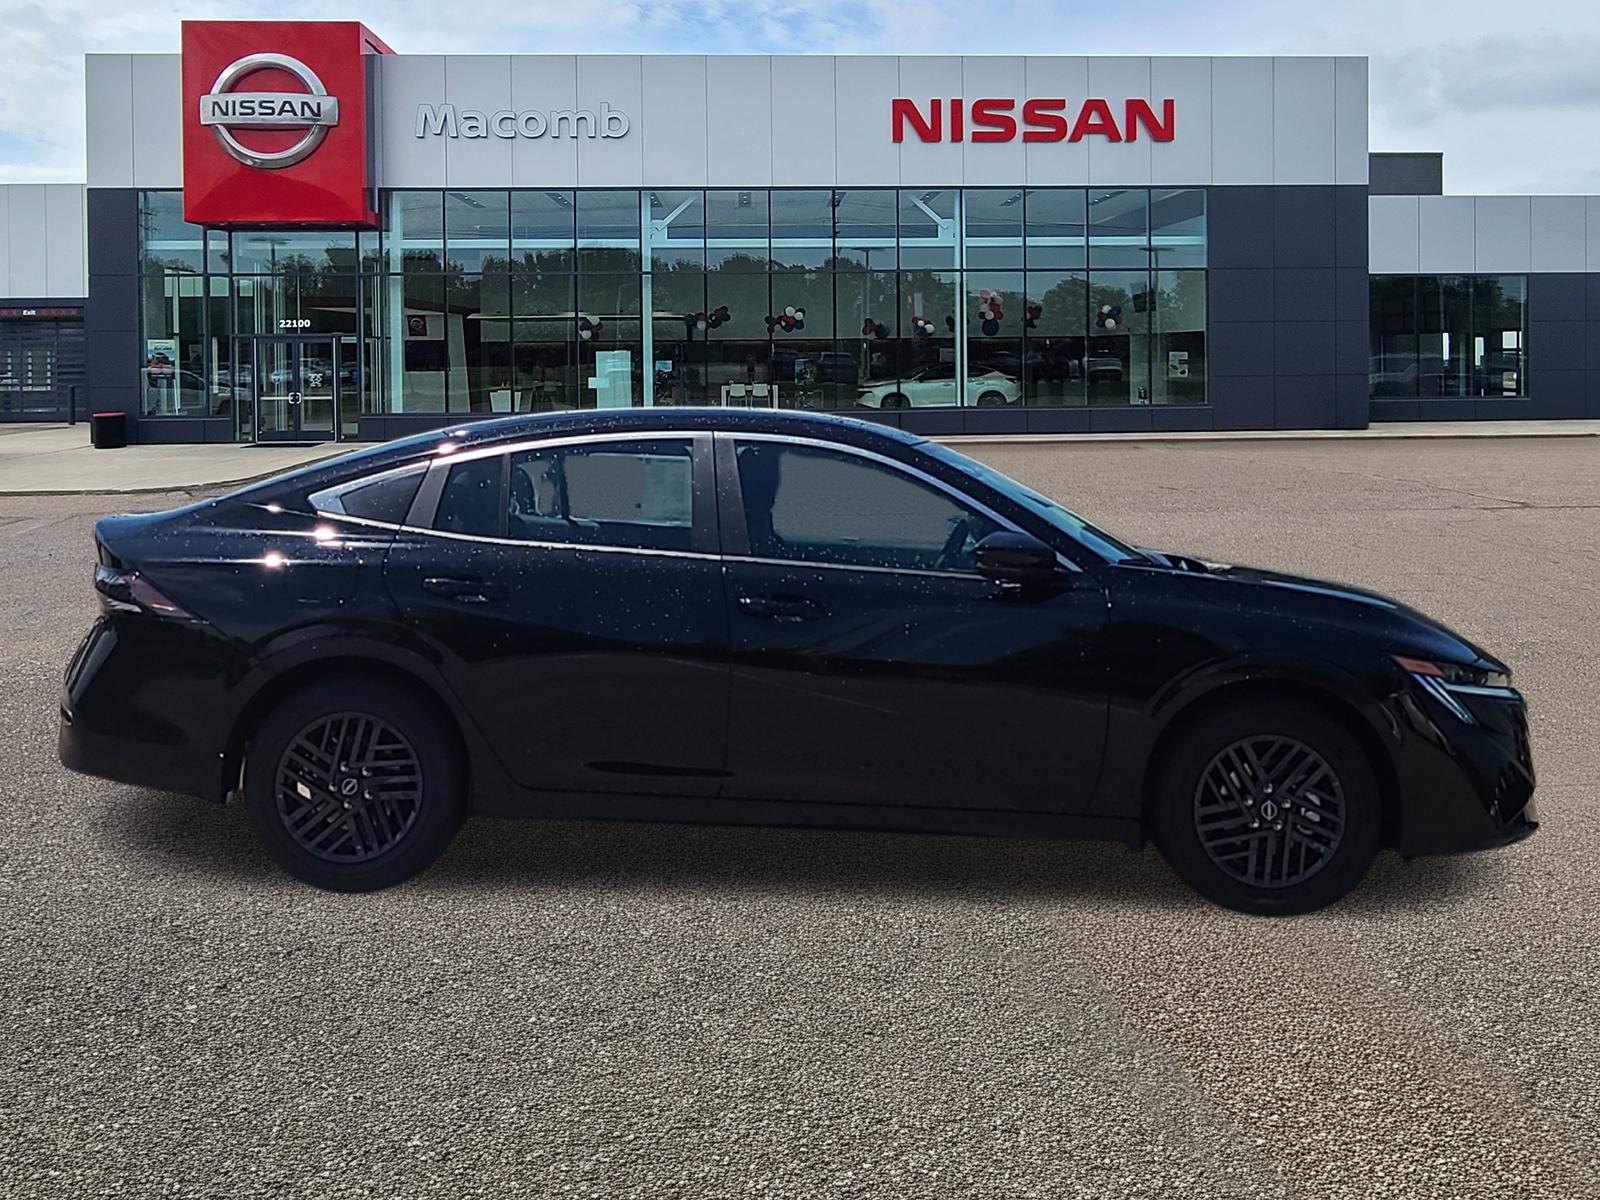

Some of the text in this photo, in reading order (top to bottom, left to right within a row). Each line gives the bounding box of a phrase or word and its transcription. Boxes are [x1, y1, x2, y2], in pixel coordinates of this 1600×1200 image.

[212, 100, 322, 118] NISSAN
[415, 101, 630, 139] Macomb
[891, 98, 1175, 143] NISSAN
[279, 319, 311, 328] 22100
